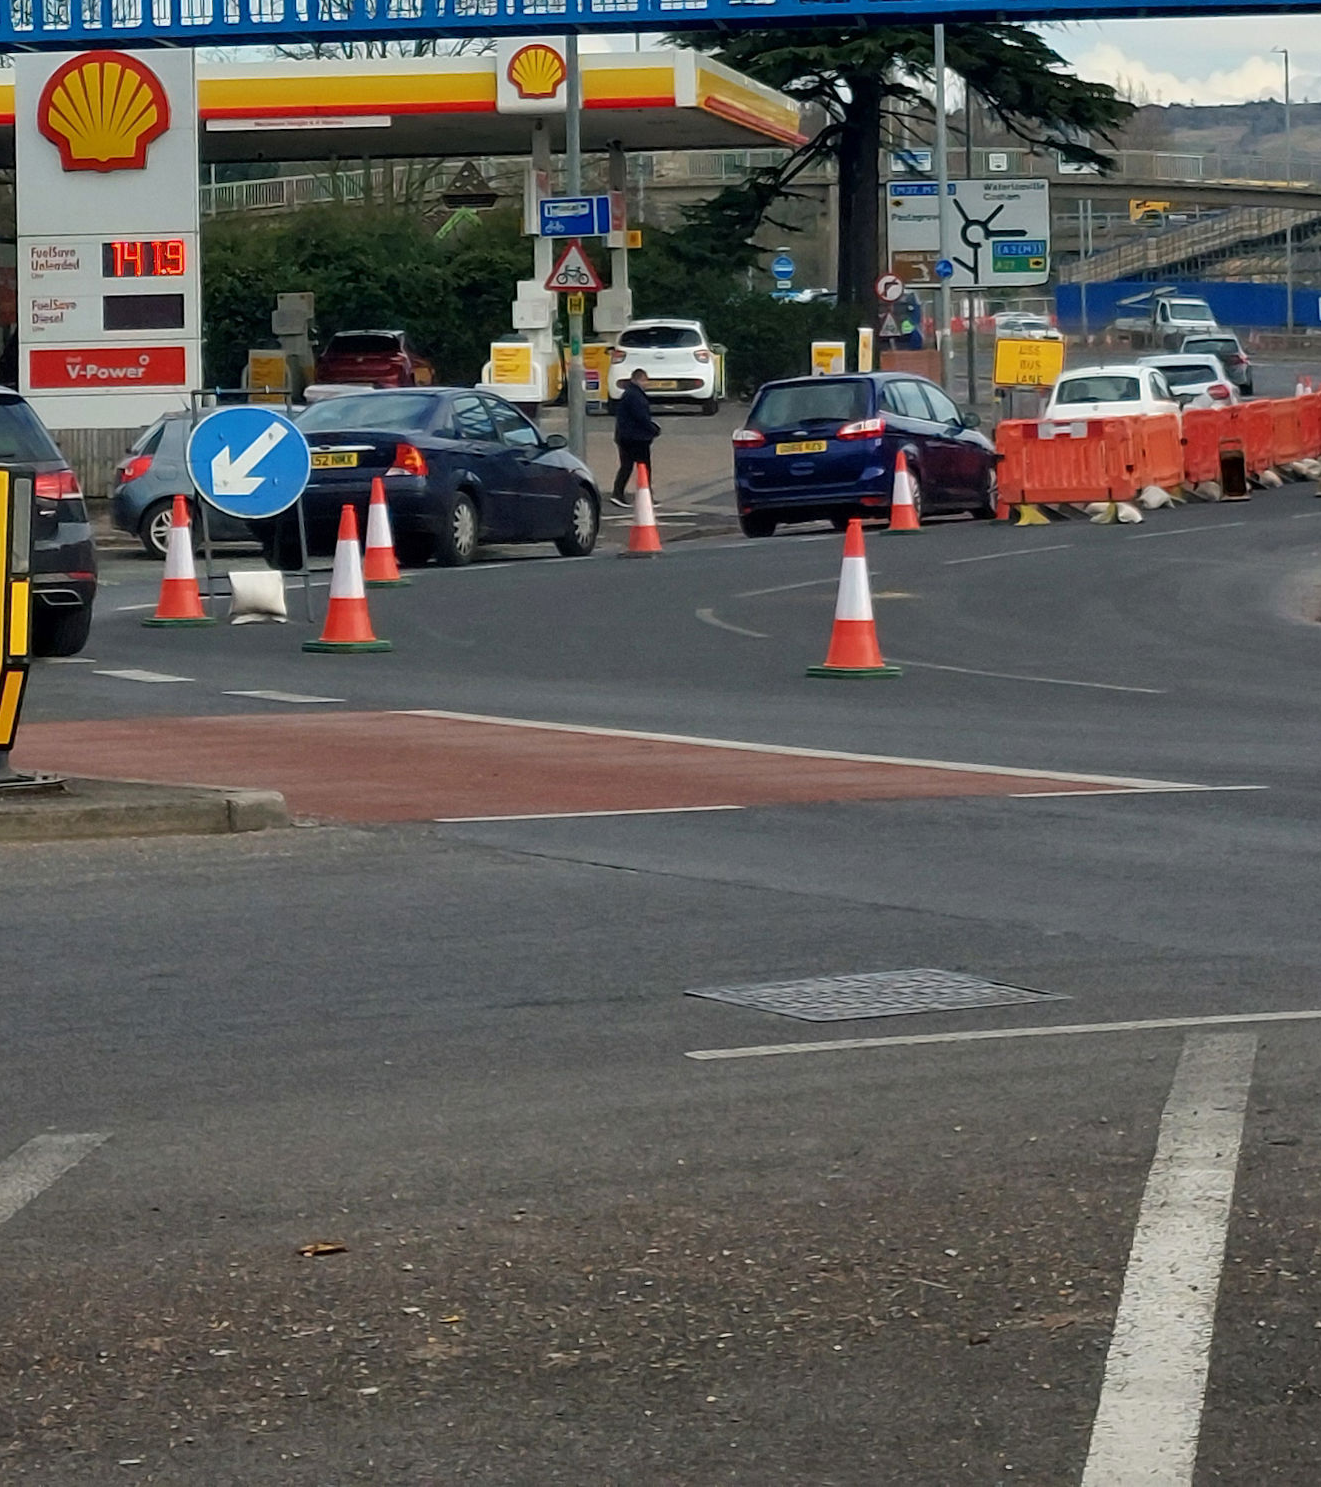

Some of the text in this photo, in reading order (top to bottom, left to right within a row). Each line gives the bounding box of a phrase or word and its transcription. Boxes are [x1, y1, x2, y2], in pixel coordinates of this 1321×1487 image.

[31, 246, 77, 259] FuelSave
[31, 258, 80, 271] Unleaded
[32, 299, 77, 311] FuelSave
[32, 312, 64, 325] Diesel
[66, 363, 146, 380] V-Power
